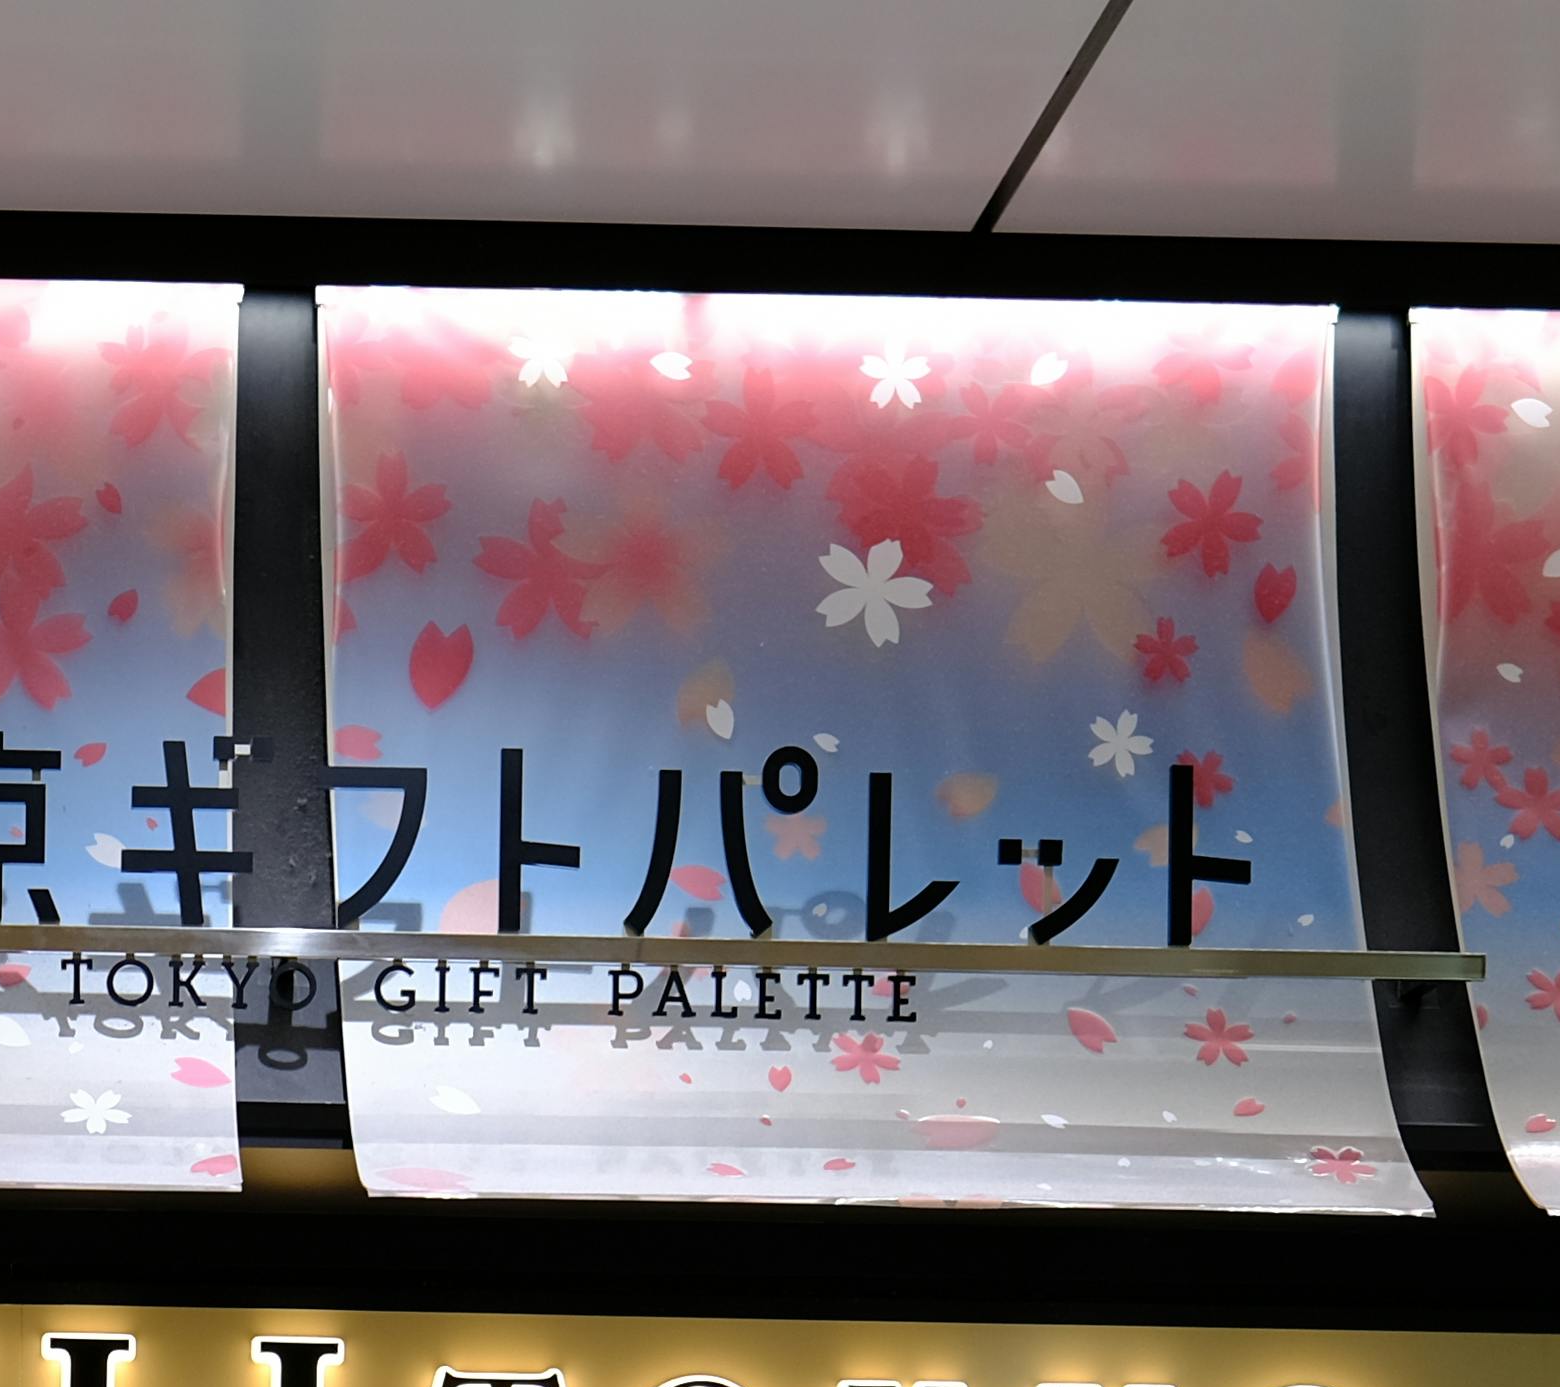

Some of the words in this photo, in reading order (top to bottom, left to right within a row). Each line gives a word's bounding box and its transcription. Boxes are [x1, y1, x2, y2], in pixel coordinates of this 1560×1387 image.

[61, 952, 318, 1012] TOKYO
[373, 960, 548, 1016] GIFT
[607, 965, 919, 1023] PALETTE
